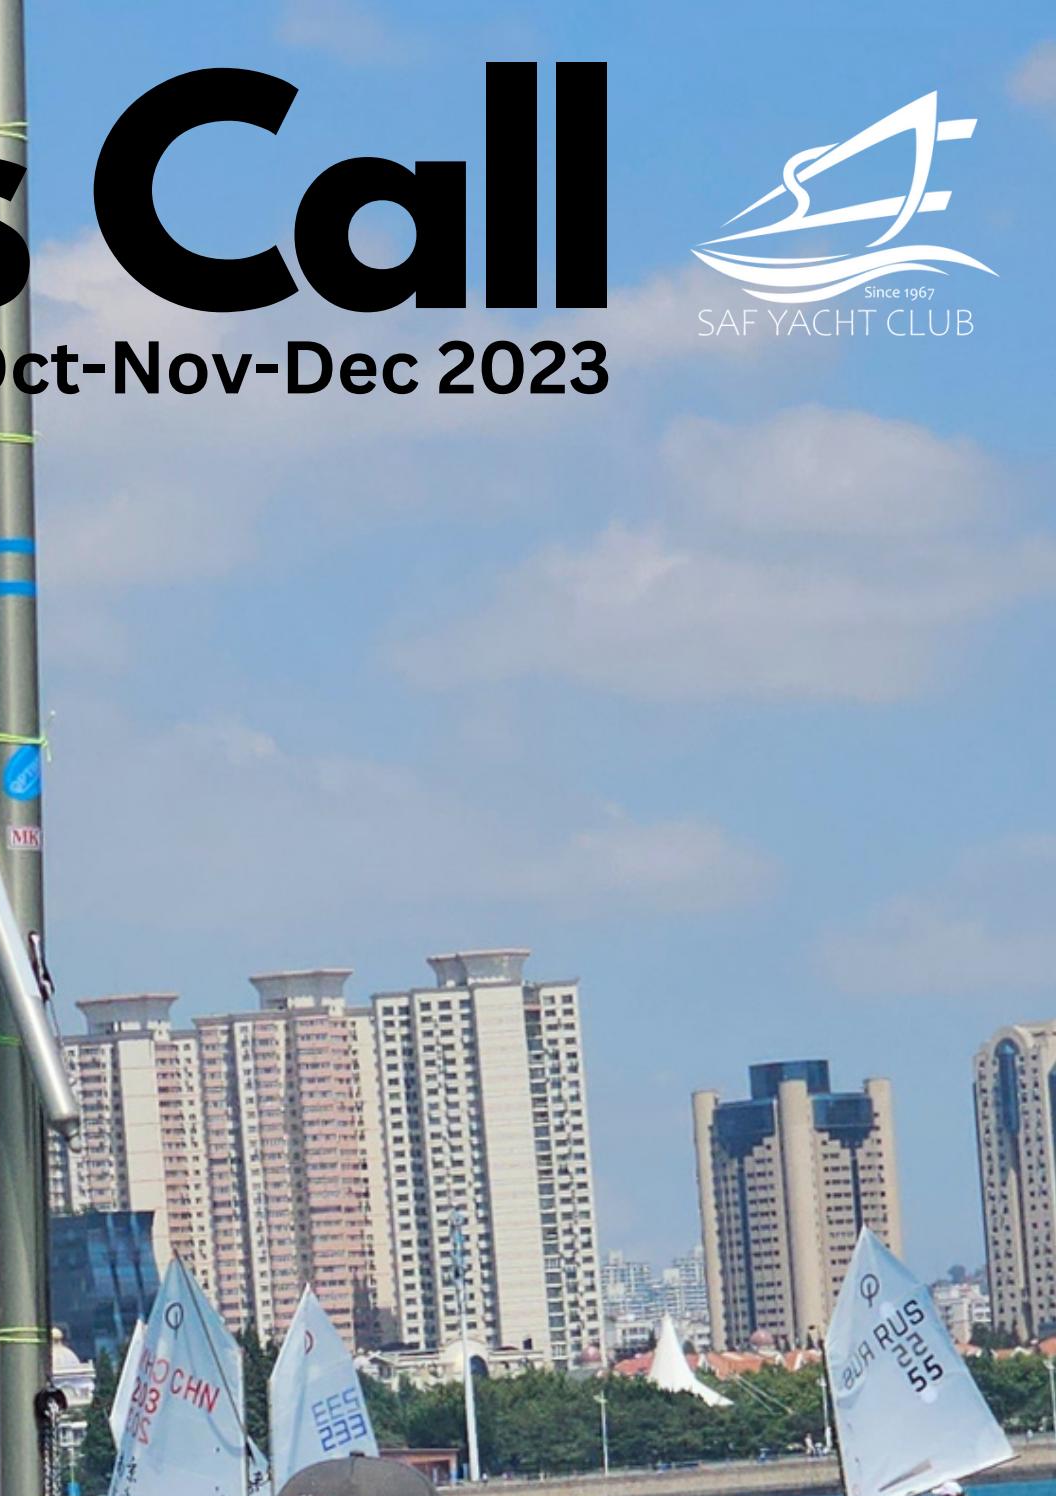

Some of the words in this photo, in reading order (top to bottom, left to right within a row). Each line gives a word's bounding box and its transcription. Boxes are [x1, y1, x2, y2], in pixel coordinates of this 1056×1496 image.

[873, 1299, 925, 1350] RUS
[169, 1368, 221, 1414] CHN
[907, 1354, 943, 1392] 55
[318, 1412, 368, 1452] 233
